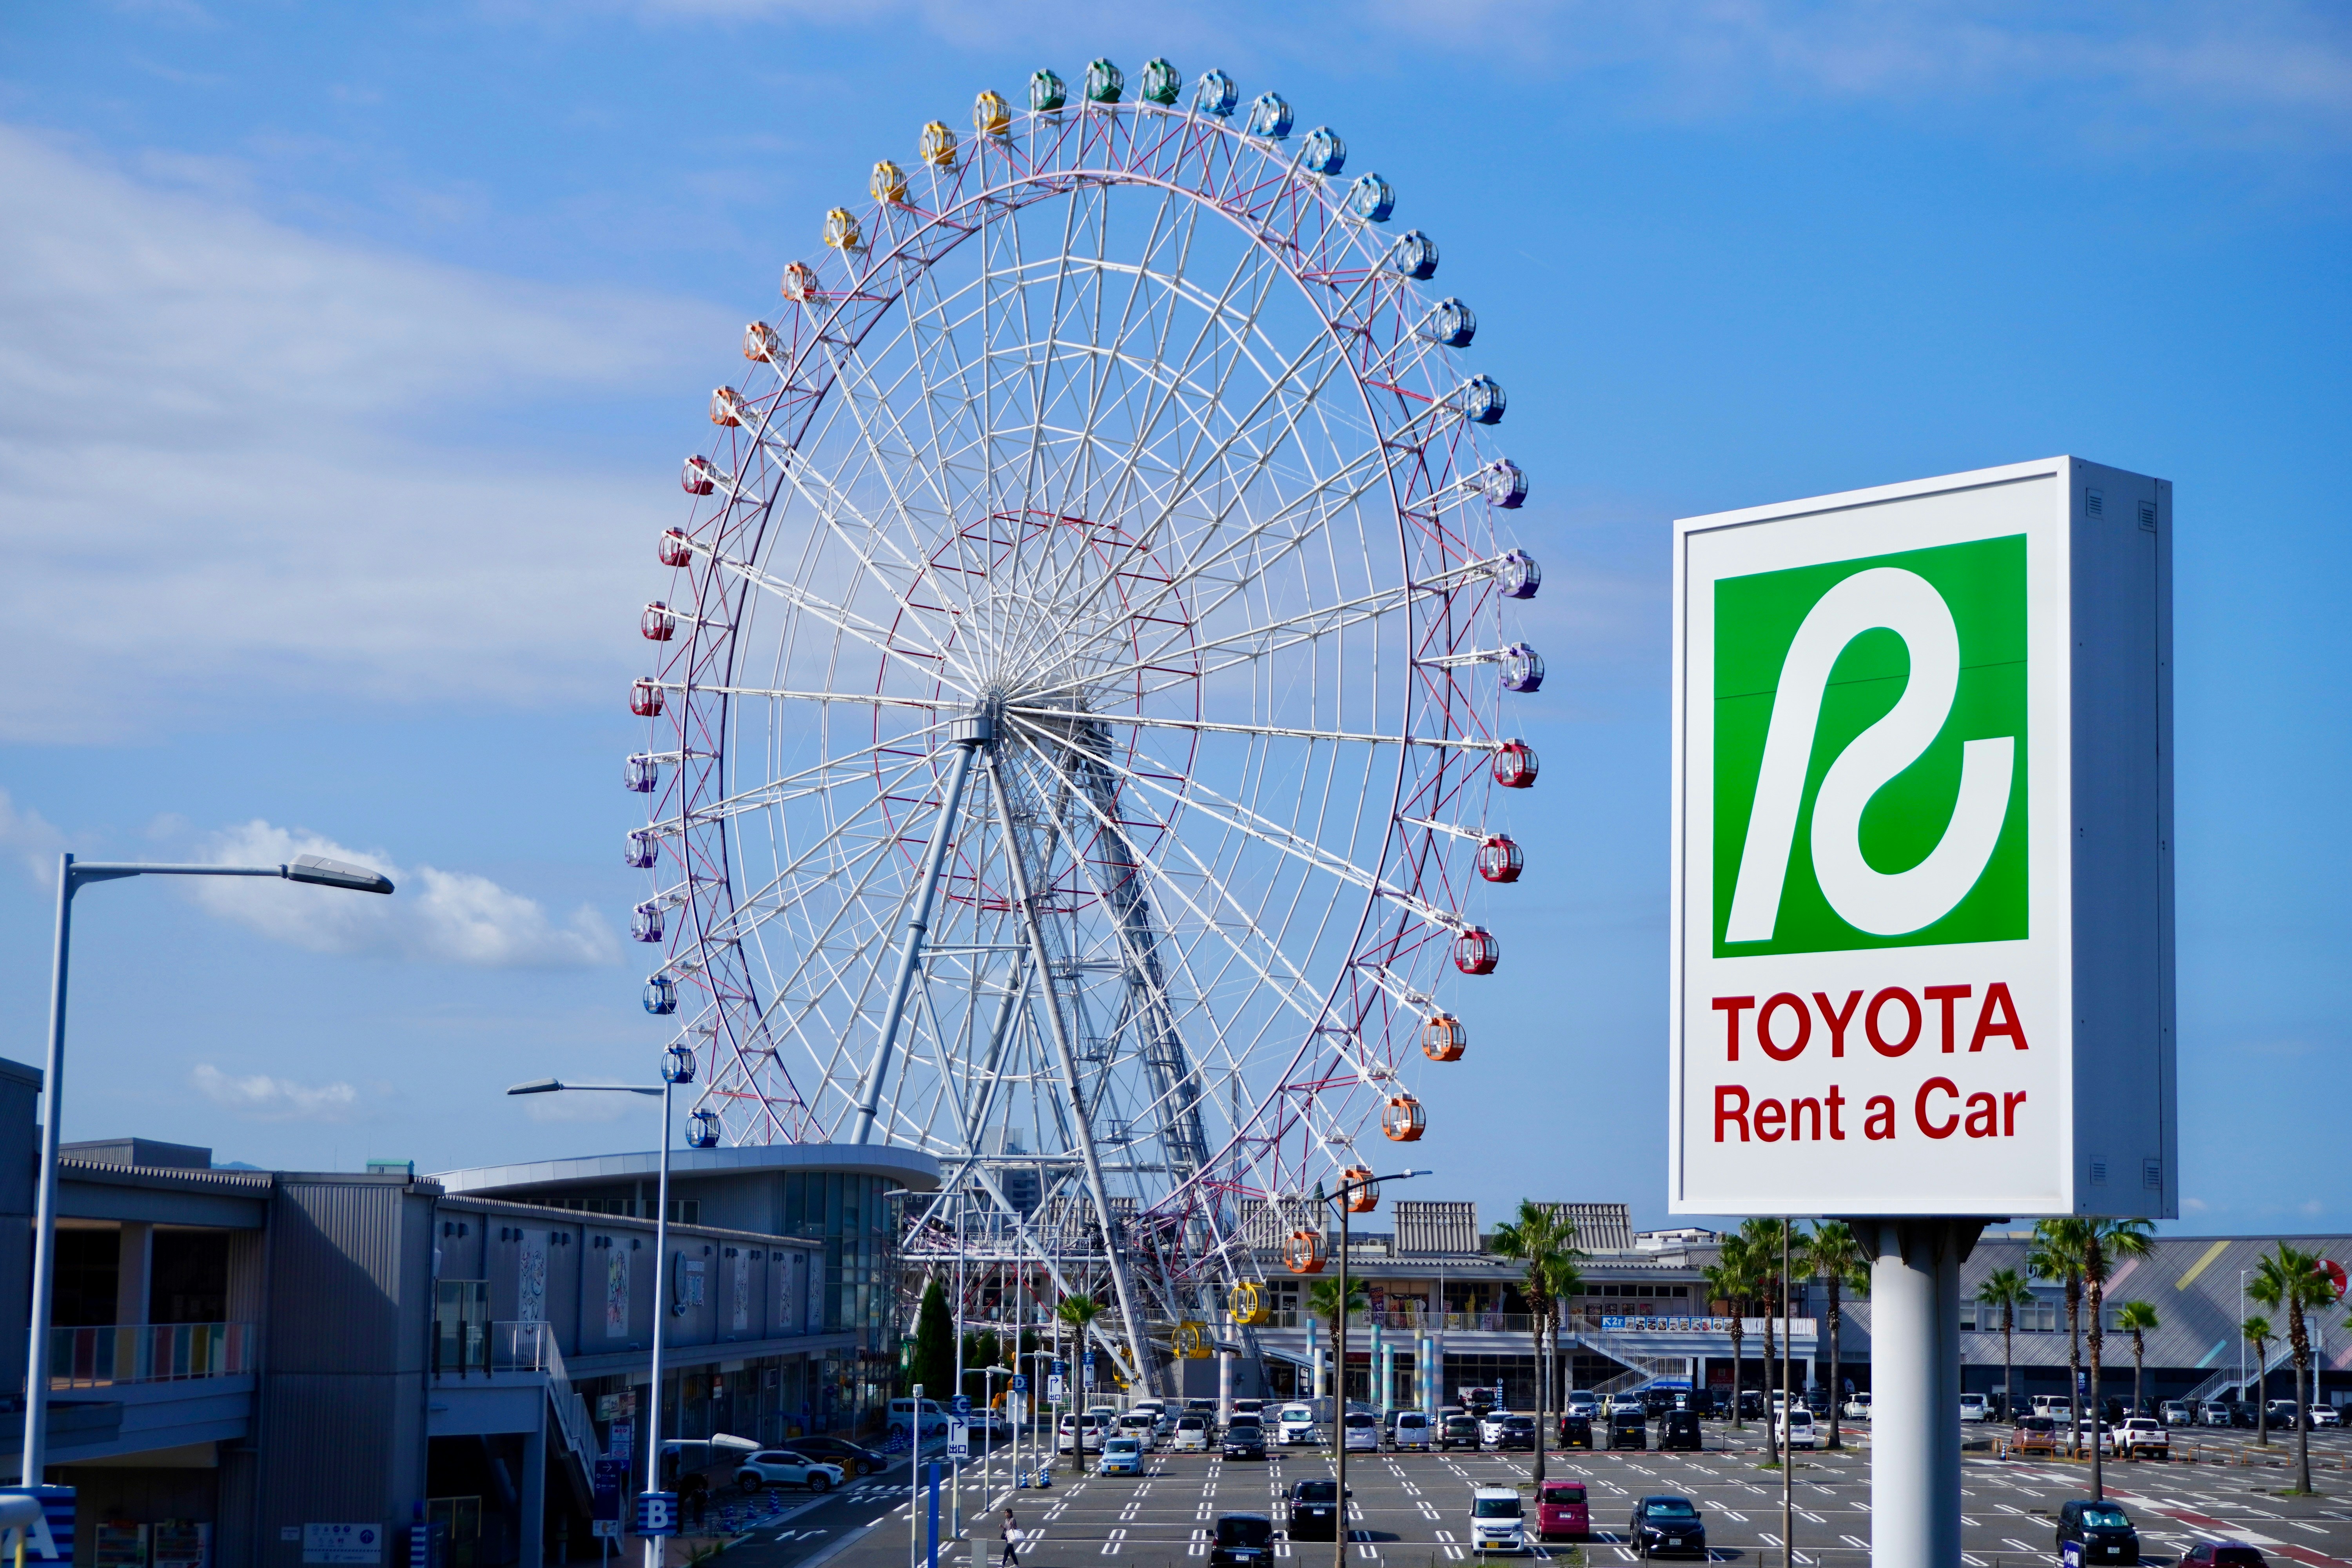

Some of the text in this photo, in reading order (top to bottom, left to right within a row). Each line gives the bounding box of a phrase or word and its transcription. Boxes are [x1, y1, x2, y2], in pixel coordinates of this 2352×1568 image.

[1711, 982, 2029, 1062] TOYOTA
[1714, 1076, 2026, 1143] Rent a Car
[1612, 1317, 1623, 1325] 2F
[1086, 1354, 1092, 1363] F
[1055, 1363, 1061, 1373] E
[1015, 1376, 1025, 1388] D
[956, 1397, 967, 1413] C
[949, 1444, 966, 1454] 出口
[647, 1499, 669, 1529] B
[2, 1512, 59, 1559] A
